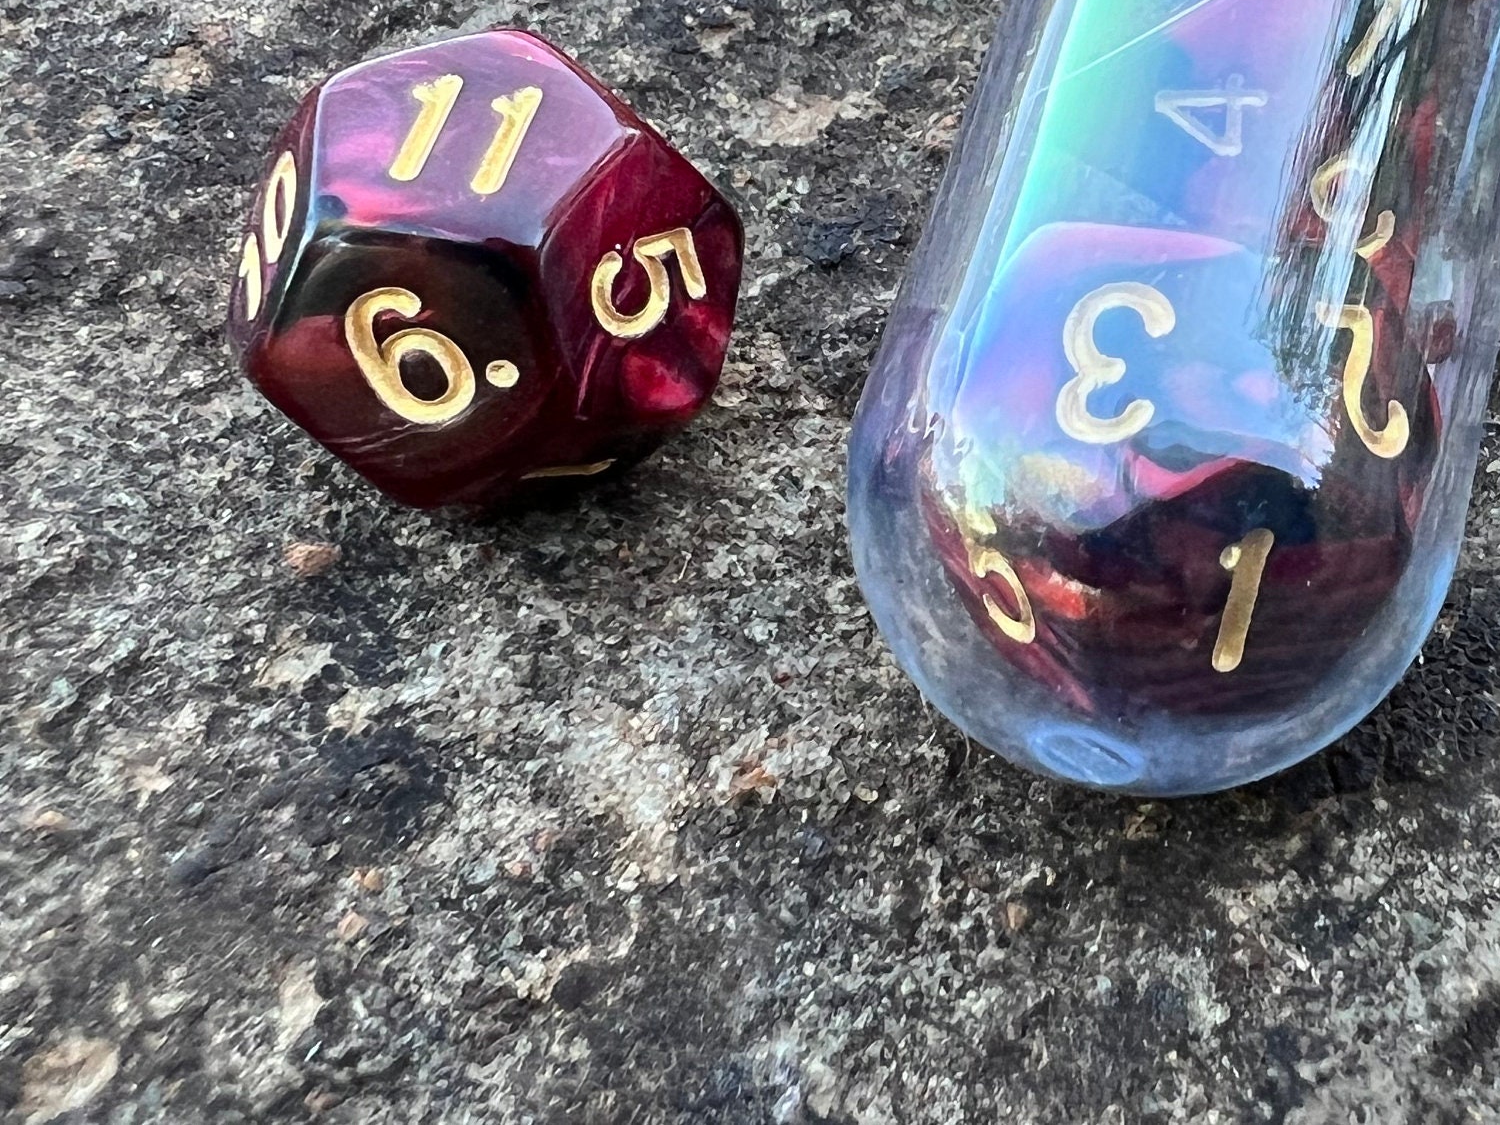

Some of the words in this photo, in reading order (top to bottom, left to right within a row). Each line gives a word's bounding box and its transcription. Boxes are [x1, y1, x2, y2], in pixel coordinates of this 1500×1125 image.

[387, 72, 544, 196] 11
[1154, 72, 1269, 157] 4
[238, 149, 298, 322] 10
[590, 226, 708, 340] 5
[1055, 281, 1177, 445] 3
[1316, 302, 1411, 460] 2
[1211, 527, 1275, 674] 1
